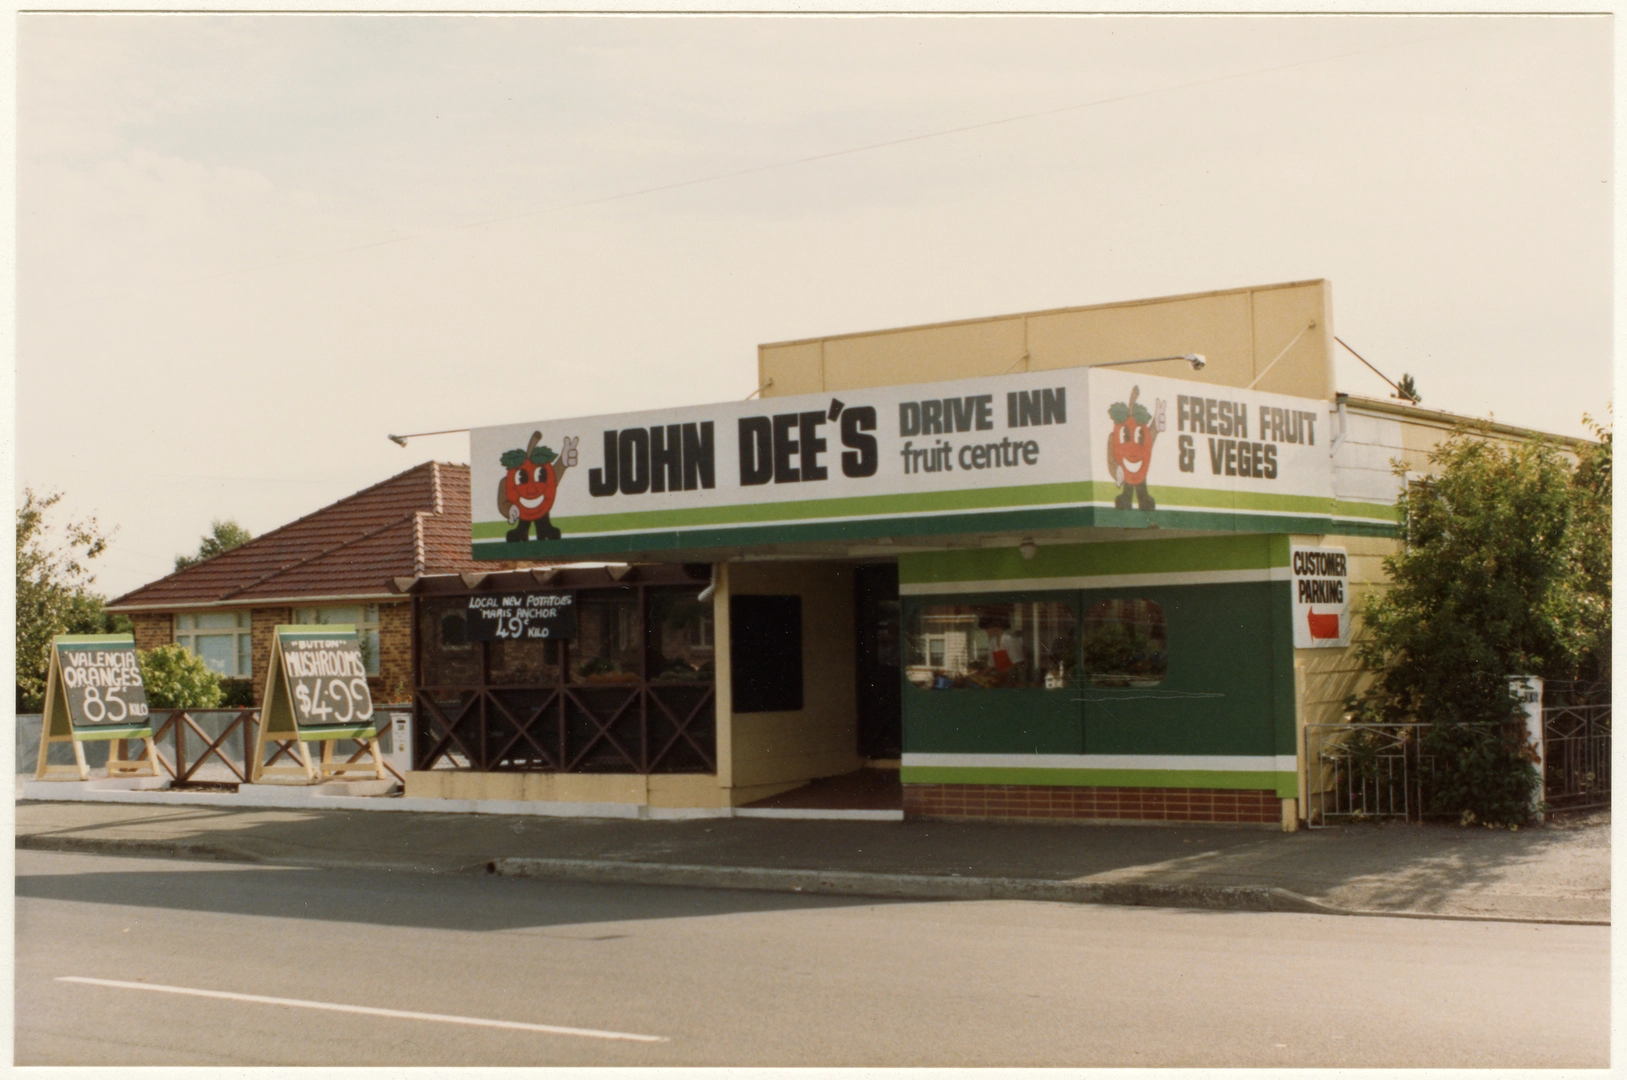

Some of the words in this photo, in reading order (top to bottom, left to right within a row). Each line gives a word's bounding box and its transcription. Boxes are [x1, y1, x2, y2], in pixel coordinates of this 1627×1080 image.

[899, 394, 993, 437] DRIVE
[1007, 387, 1067, 428] INN
[1177, 394, 1247, 438] FRESH
[1259, 405, 1317, 446] FRUIT
[588, 421, 715, 497] JOHN
[738, 398, 878, 486] DEE'S
[901, 439, 953, 474] fruit
[958, 437, 1039, 470] centre
[1178, 434, 1195, 473] &
[1208, 437, 1278, 479] VEGES
[1293, 551, 1347, 576] CUSTOMER
[468, 597, 498, 609] LOCAL
[502, 596, 522, 607] NEW
[526, 595, 572, 607] POTATOES
[1298, 579, 1343, 603] PARKING
[528, 627, 549, 638] KILO
[64, 666, 143, 687] ORANGES
[285, 650, 367, 677] MUSHROOMS
[129, 703, 149, 716] KILO
